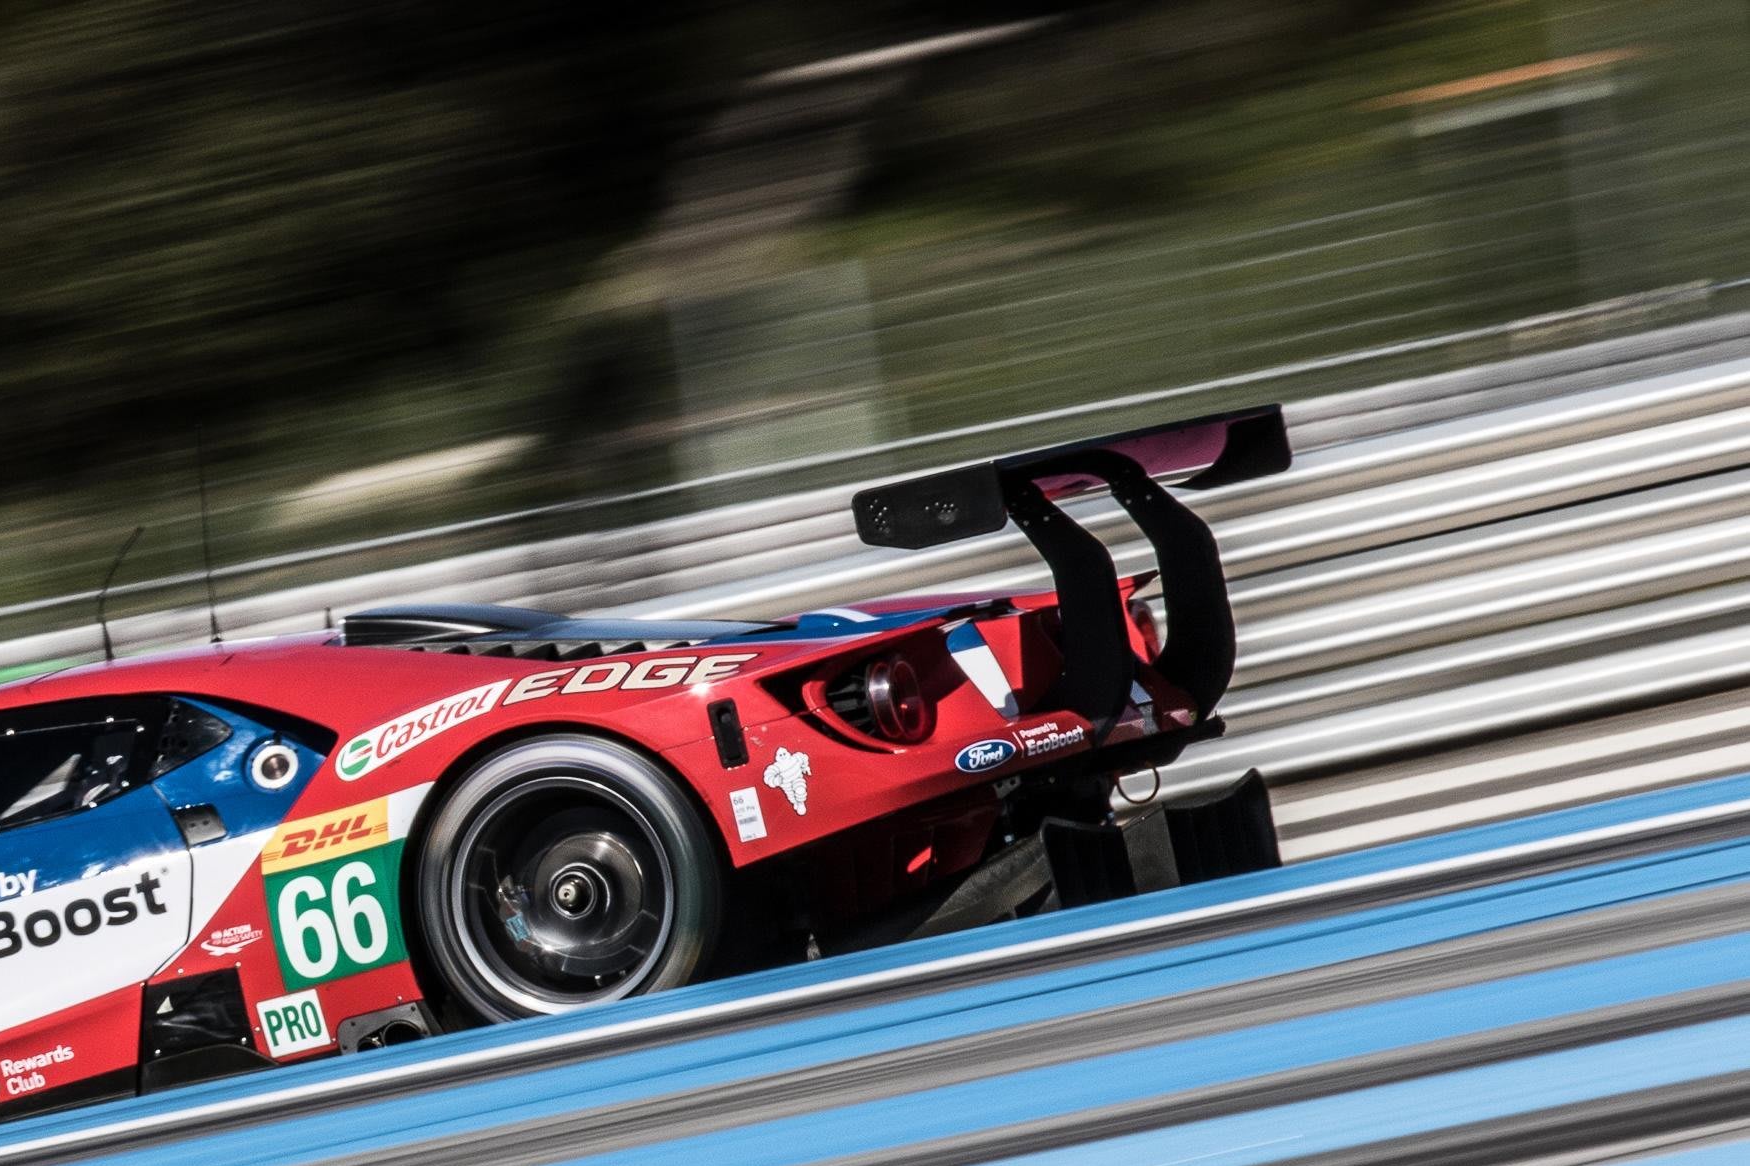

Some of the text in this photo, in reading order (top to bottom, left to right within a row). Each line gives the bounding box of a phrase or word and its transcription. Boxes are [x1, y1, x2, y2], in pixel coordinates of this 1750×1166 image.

[376, 653, 760, 760] Castrol EDGE
[968, 743, 1004, 769] Ford
[1025, 725, 1085, 757] EcoBoost
[281, 814, 372, 858] DHL
[277, 860, 389, 979] 66
[264, 1000, 322, 1047] PRO
[0, 1044, 75, 1078] Rewards
[6, 1072, 46, 1096] Club
